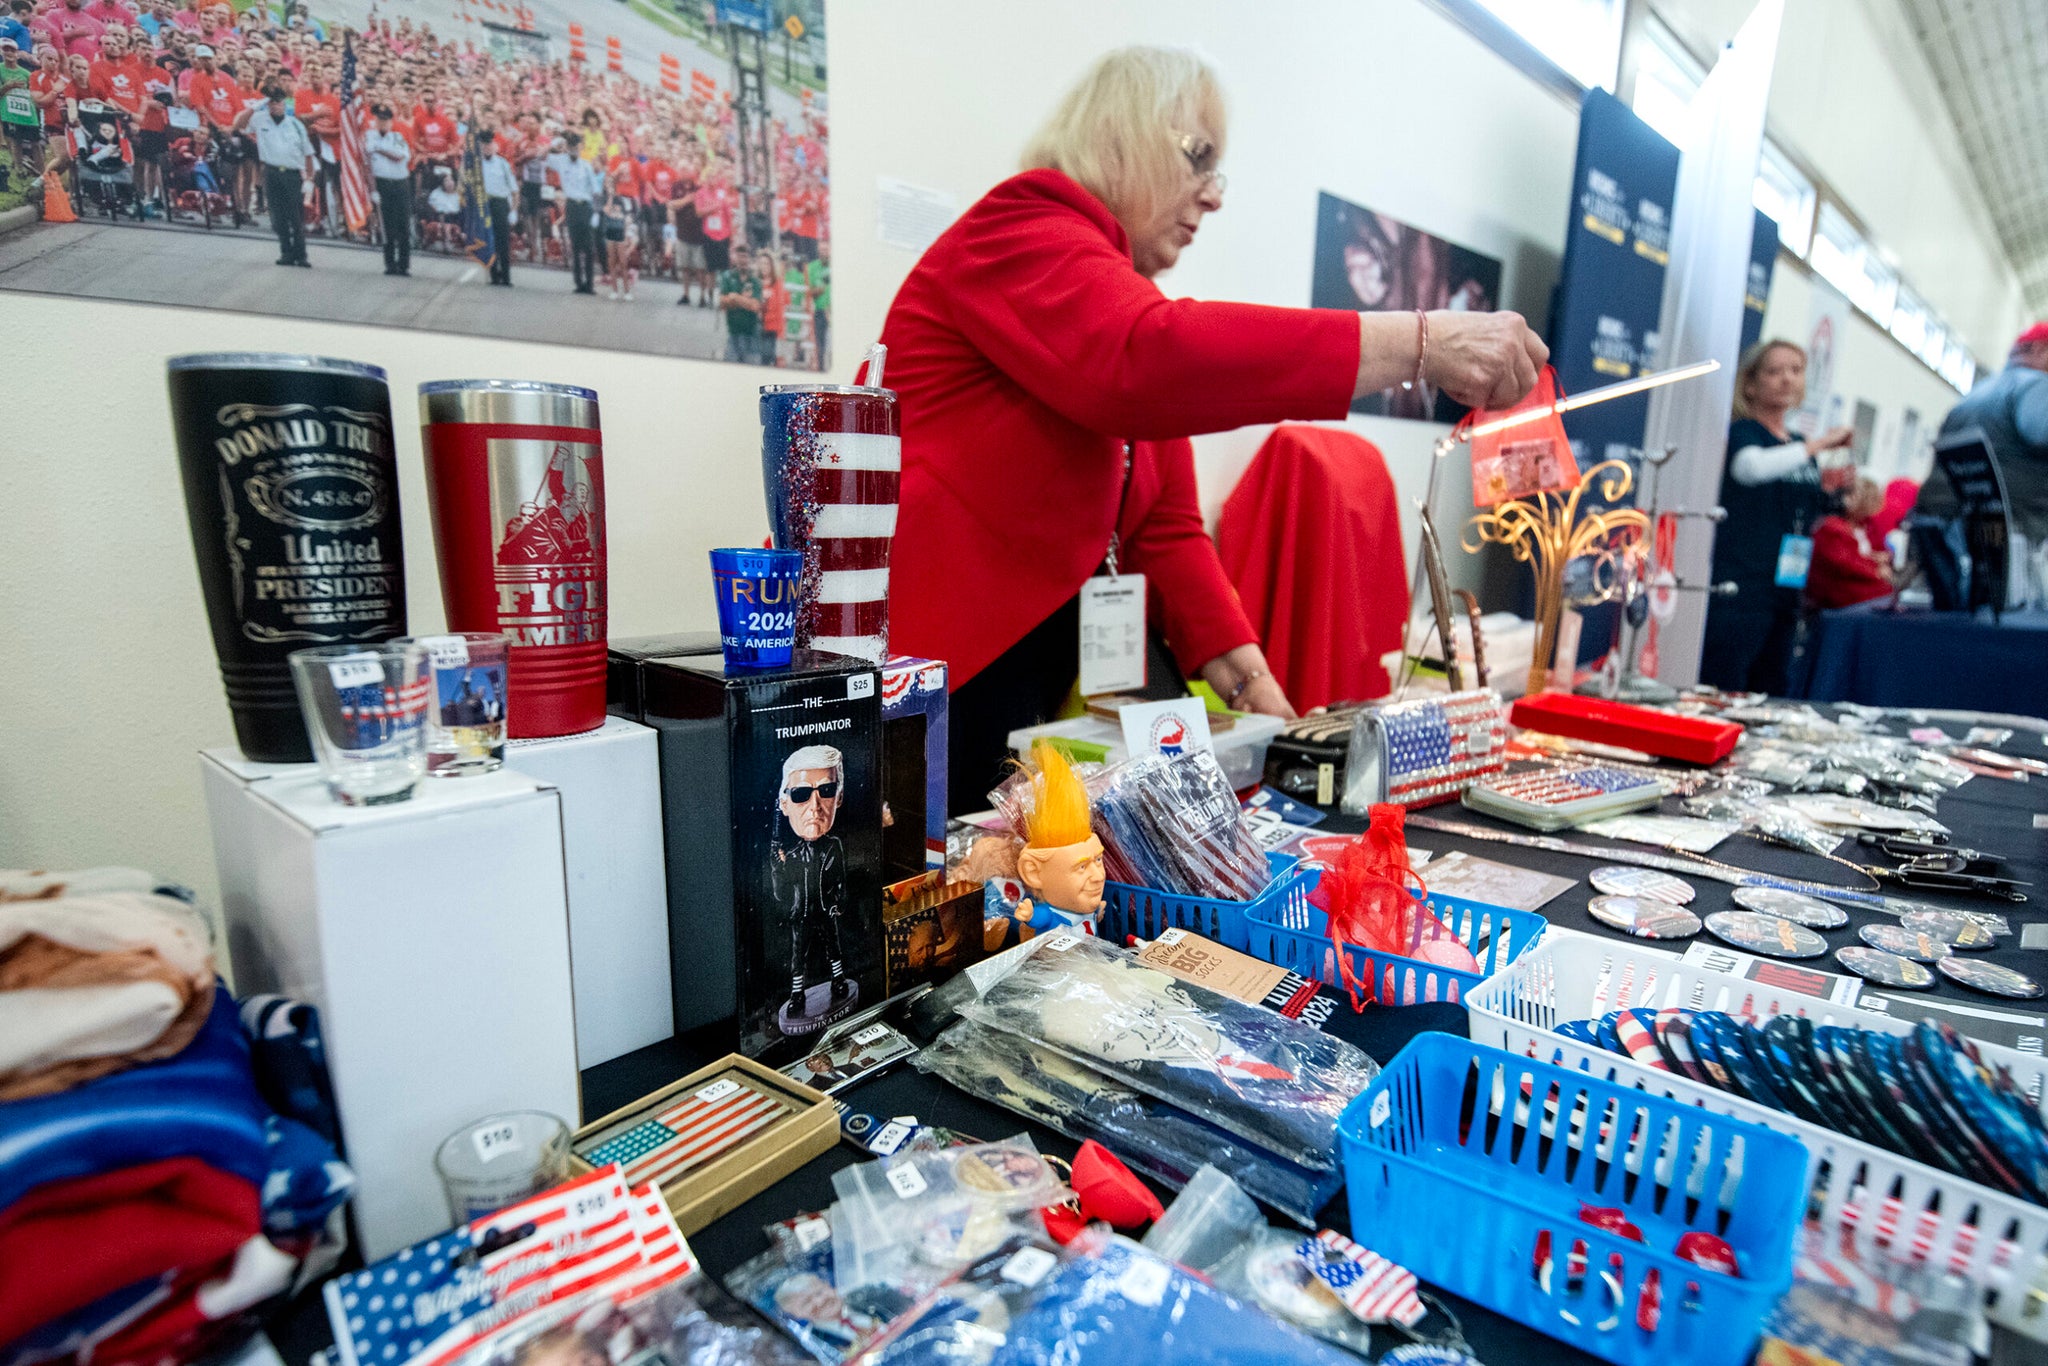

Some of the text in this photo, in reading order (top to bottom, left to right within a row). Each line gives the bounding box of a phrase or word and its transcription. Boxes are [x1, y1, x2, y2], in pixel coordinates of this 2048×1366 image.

[215, 419, 327, 466] DONALD
[330, 421, 381, 453] TRU
[281, 533, 383, 565] United
[743, 558, 764, 569] $10
[256, 576, 393, 600] PRESIDEN
[495, 581, 604, 613] FIGH
[714, 576, 802, 604] TRUM
[501, 623, 601, 648] AMERI
[721, 636, 794, 649] AKE AMERICA
[853, 679, 869, 691] $25
[803, 696, 824, 710] THE
[775, 717, 852, 740] TRUMPINATOR
[1162, 931, 1178, 942] $15
[1170, 947, 1210, 974] BIG
[1195, 956, 1223, 979] SOCKS
[786, 1005, 851, 1034] TRUMPINATOR
[1296, 995, 1339, 1030] 2024
[859, 1026, 879, 1040] $10
[483, 1126, 513, 1147] $10
[879, 1129, 899, 1147] $10
[576, 1193, 606, 1216] $10
